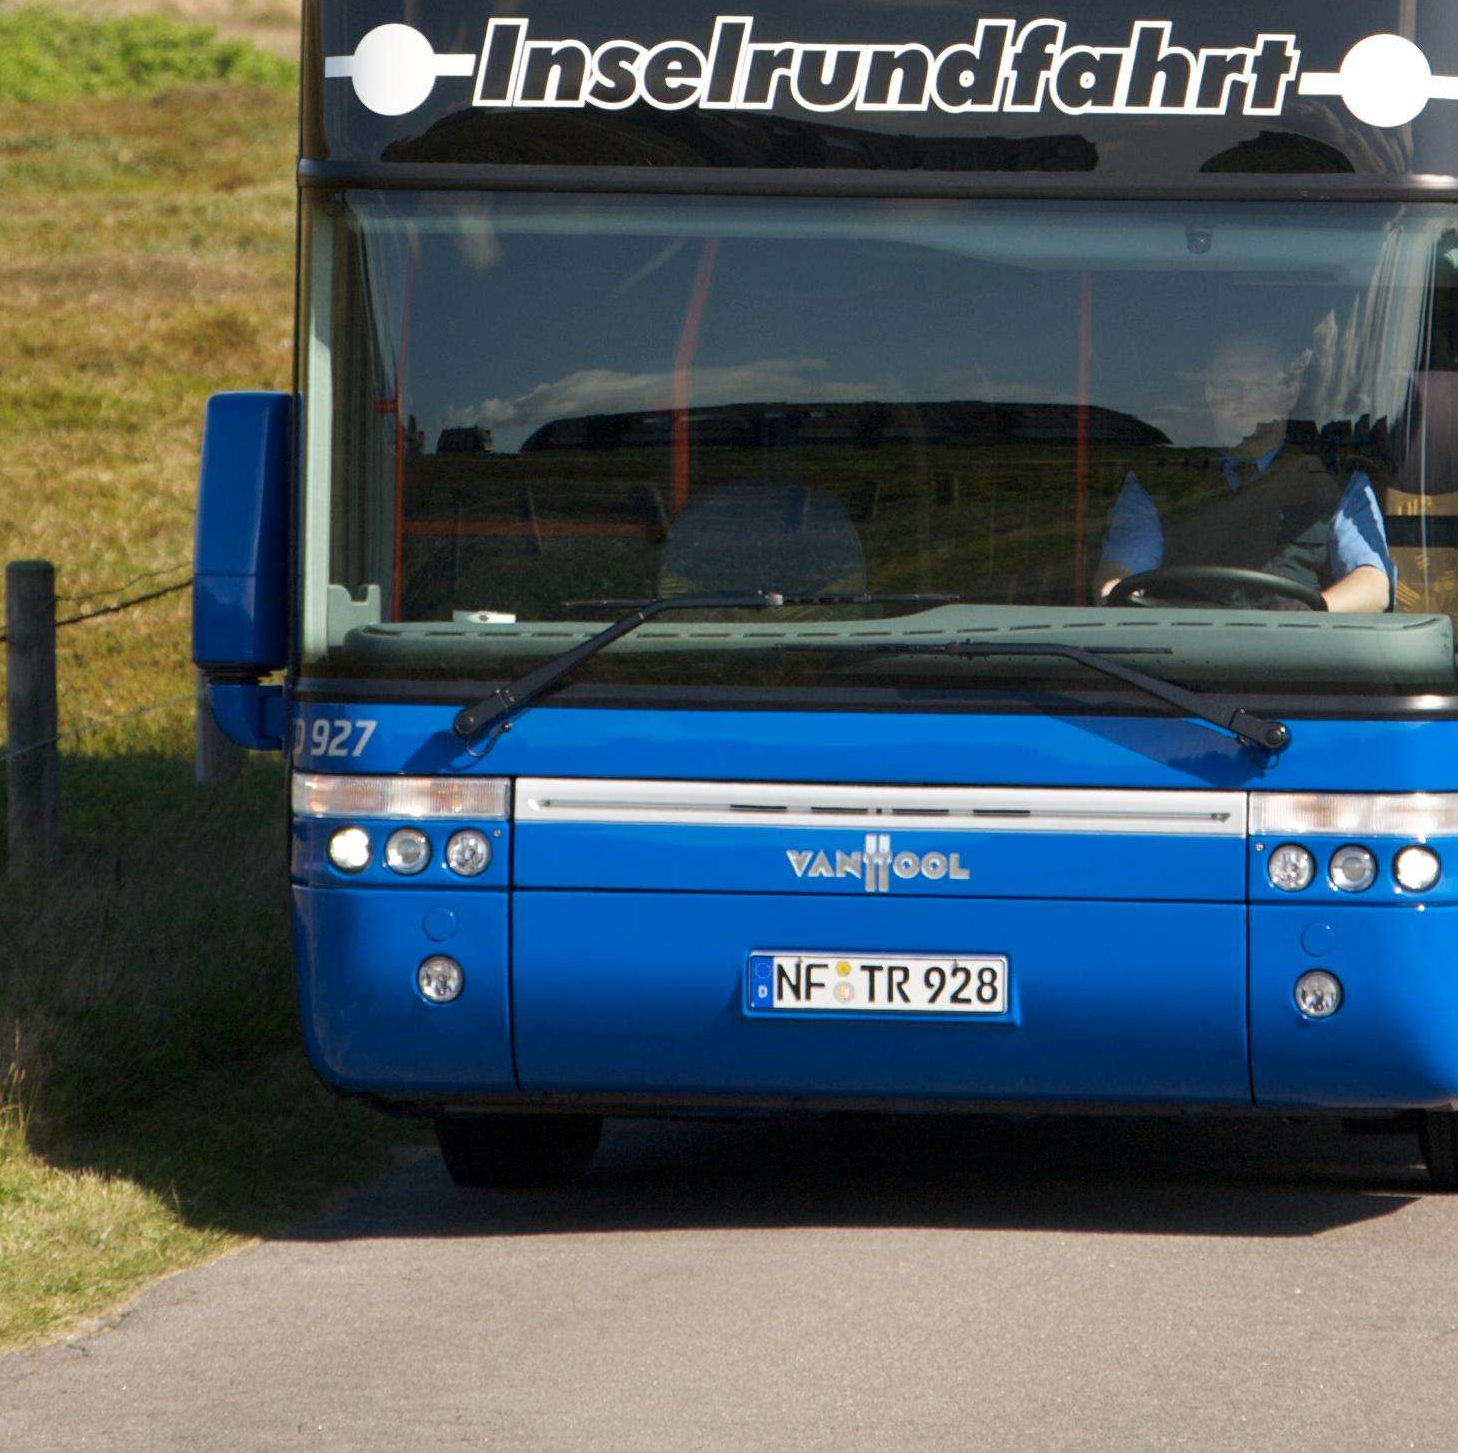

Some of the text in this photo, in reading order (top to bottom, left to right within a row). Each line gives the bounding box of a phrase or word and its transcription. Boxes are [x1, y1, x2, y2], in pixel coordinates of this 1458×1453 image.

[471, 15, 1301, 117] Inselrundfahrt
[310, 717, 378, 756] 927
[776, 963, 829, 1002] NF
[860, 965, 911, 1004] TR
[923, 966, 999, 1005] 928
